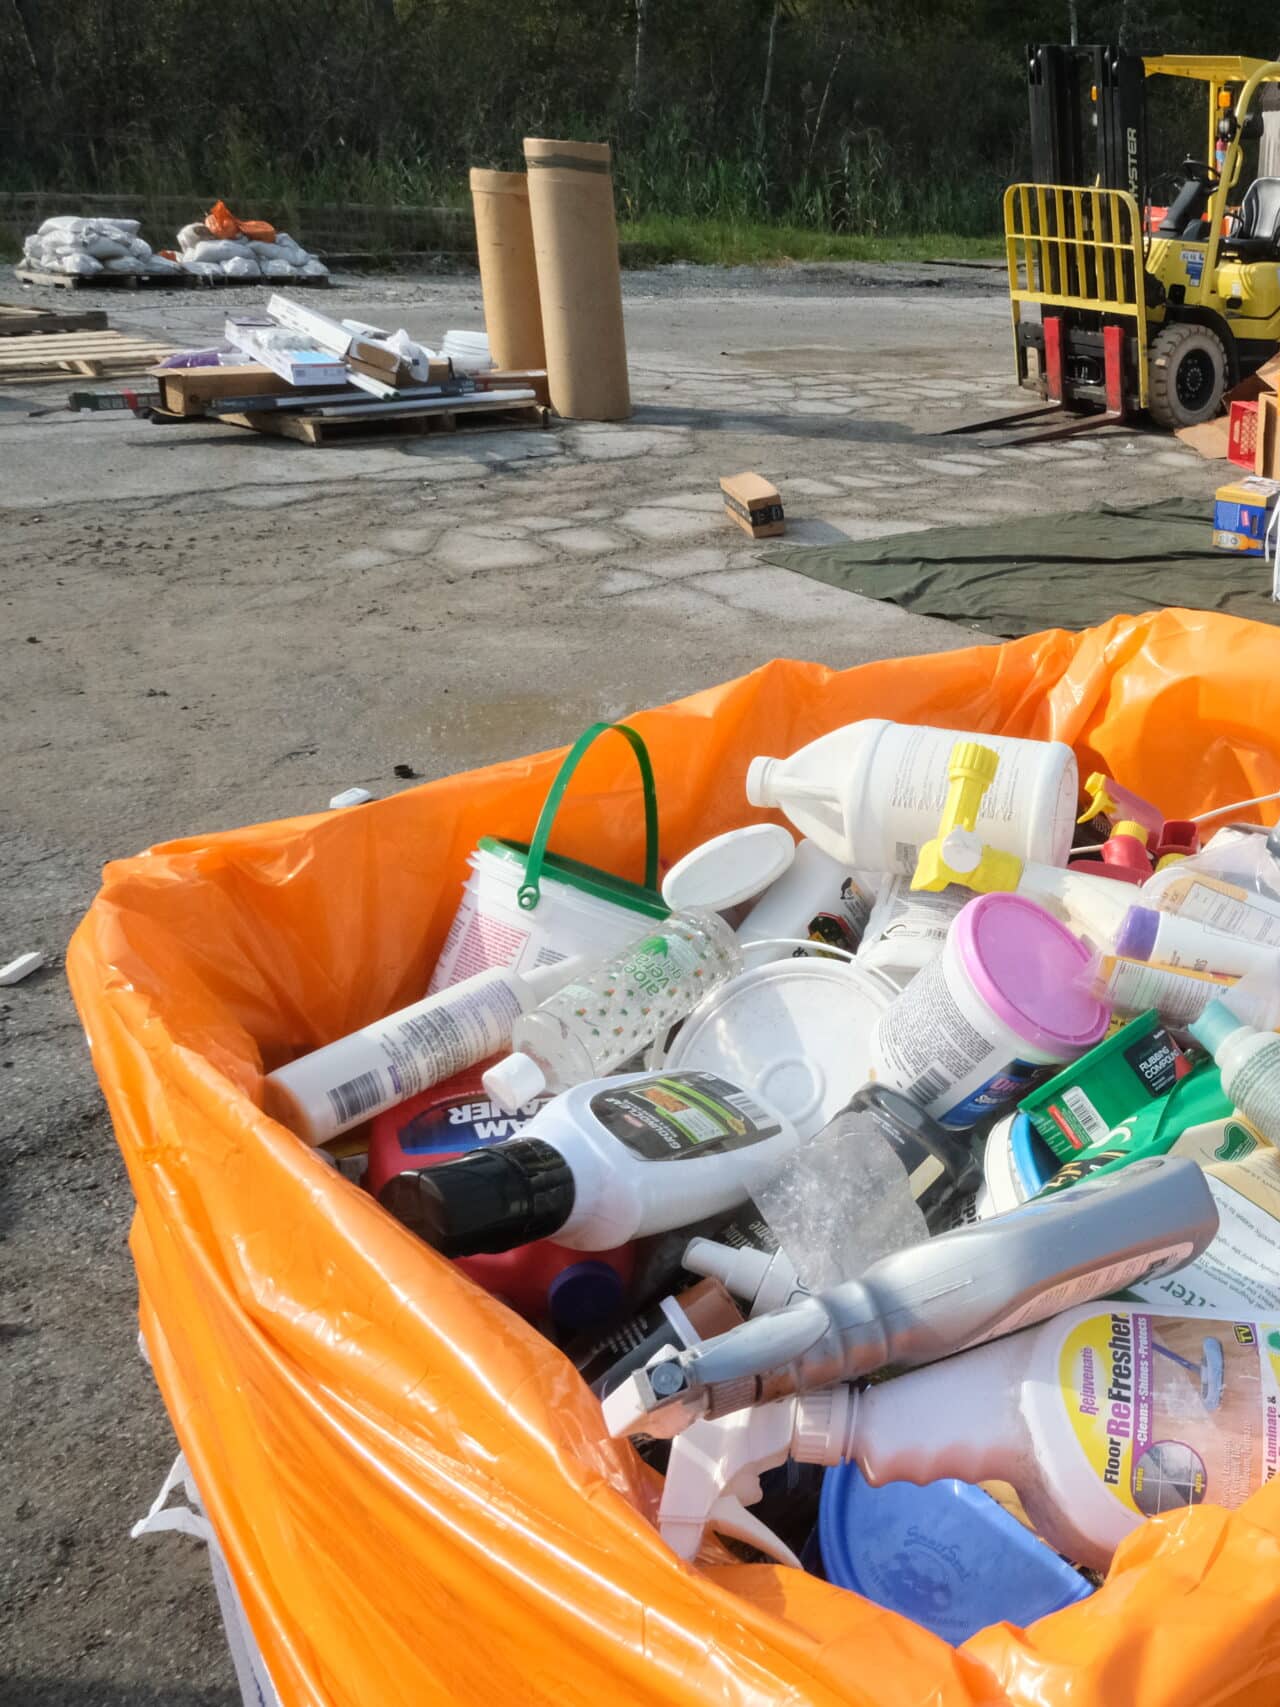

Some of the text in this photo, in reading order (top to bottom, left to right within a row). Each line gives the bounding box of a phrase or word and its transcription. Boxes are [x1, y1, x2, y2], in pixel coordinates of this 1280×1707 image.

[1127, 128, 1138, 198] YSTER
[624, 964, 660, 997] aloe
[636, 953, 670, 990] vera
[662, 960, 681, 980] gel
[1139, 1045, 1169, 1071] RUBBING
[604, 1096, 682, 1151] GROUNDCLEAR
[1237, 1327, 1252, 1344] TV
[1079, 1345, 1099, 1415] Rejuvenate
[1103, 1313, 1132, 1485] Floor ReFresher
[1138, 1317, 1149, 1440] Cleans Shines Protects
[1269, 1396, 1277, 1406] &
[1265, 1408, 1277, 1463] Laminate
